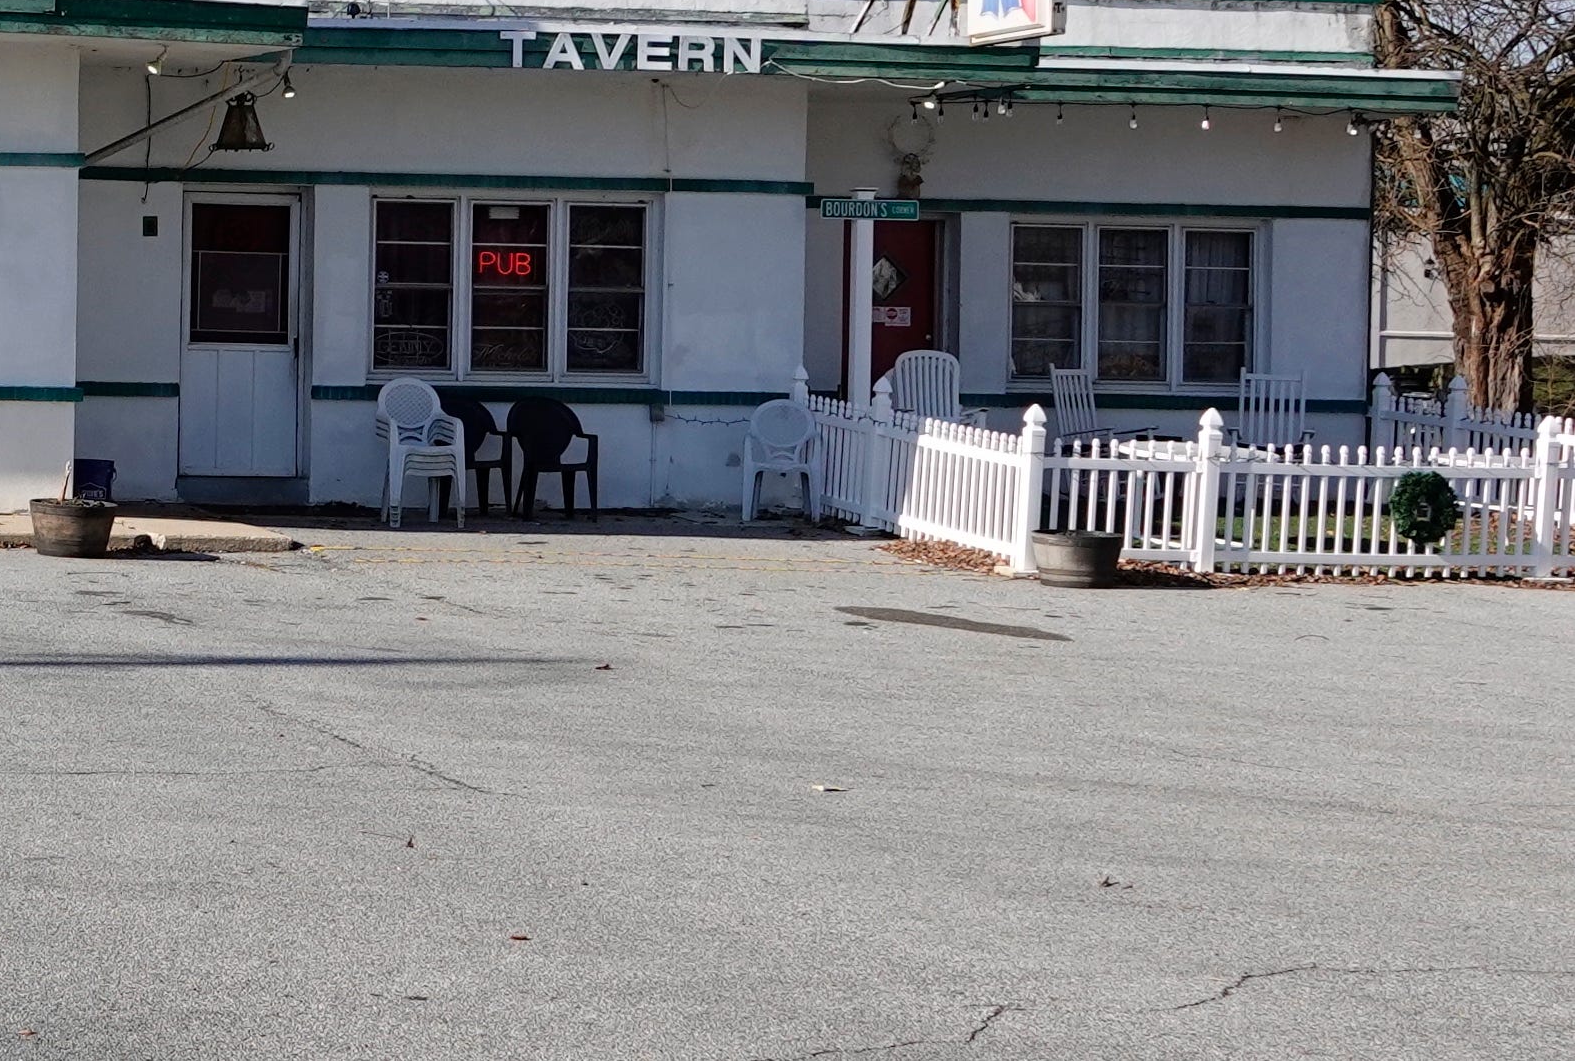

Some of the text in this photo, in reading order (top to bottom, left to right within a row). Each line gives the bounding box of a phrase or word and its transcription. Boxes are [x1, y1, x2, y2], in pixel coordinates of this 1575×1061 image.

[500, 30, 761, 74] TAVERN
[826, 201, 887, 217] BOURDON'S
[478, 251, 532, 275] PUB
